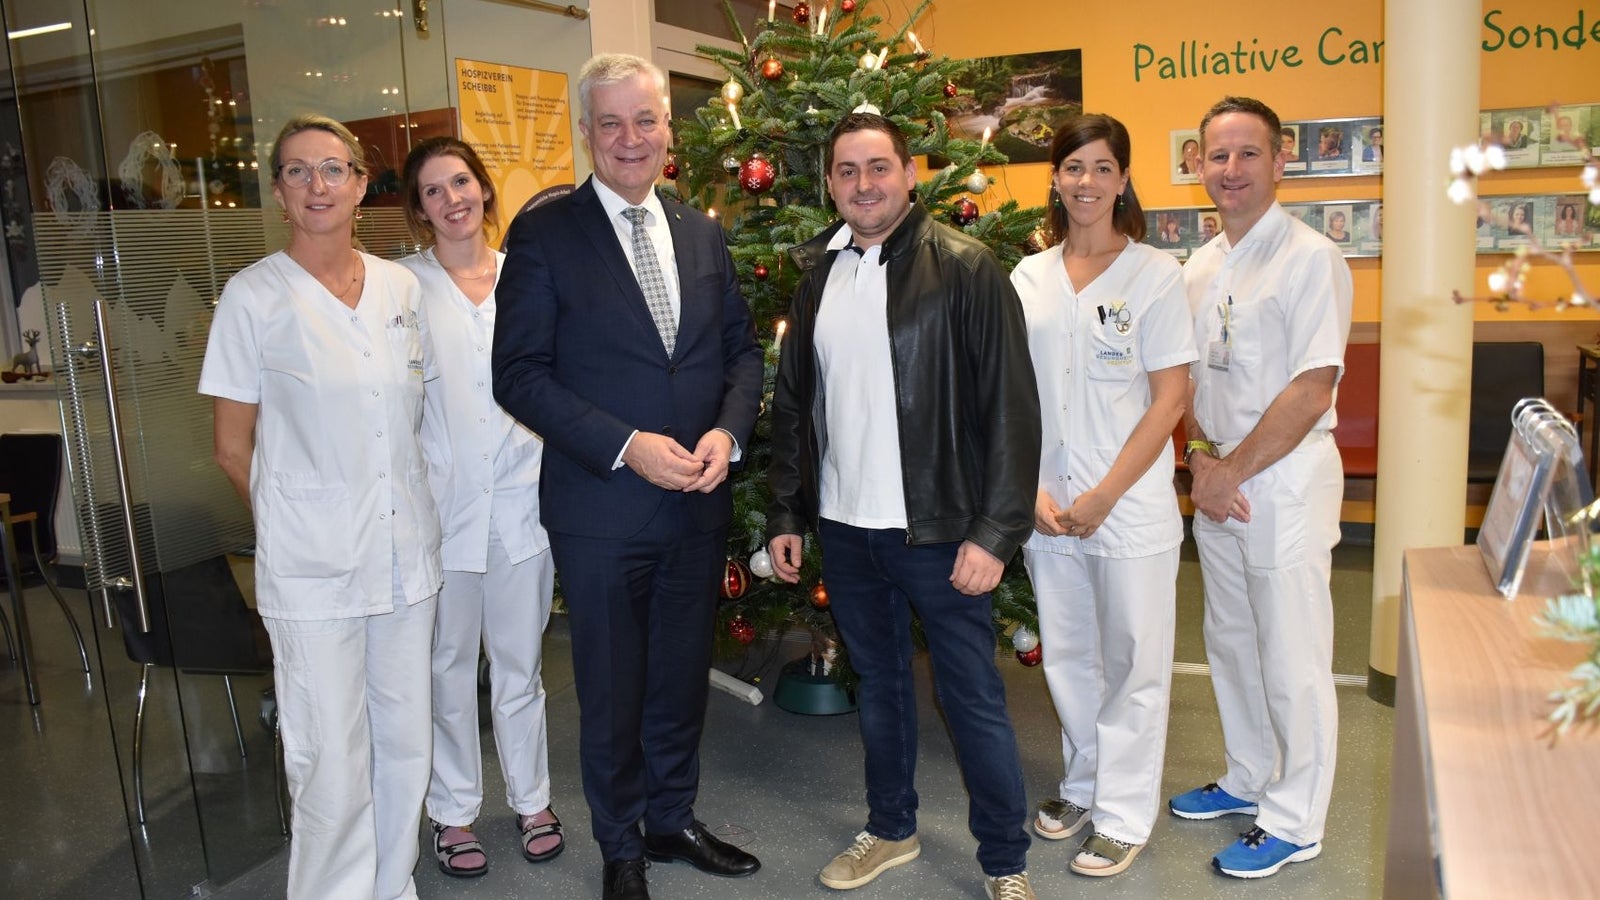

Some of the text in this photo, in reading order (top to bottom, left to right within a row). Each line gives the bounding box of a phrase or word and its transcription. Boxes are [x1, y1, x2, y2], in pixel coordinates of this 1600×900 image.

[1133, 38, 1303, 82] Palliative
[1318, 27, 1385, 66] Car
[461, 68, 513, 83] HOSPIZVEREIN
[462, 81, 497, 94] SCHEIBBS
